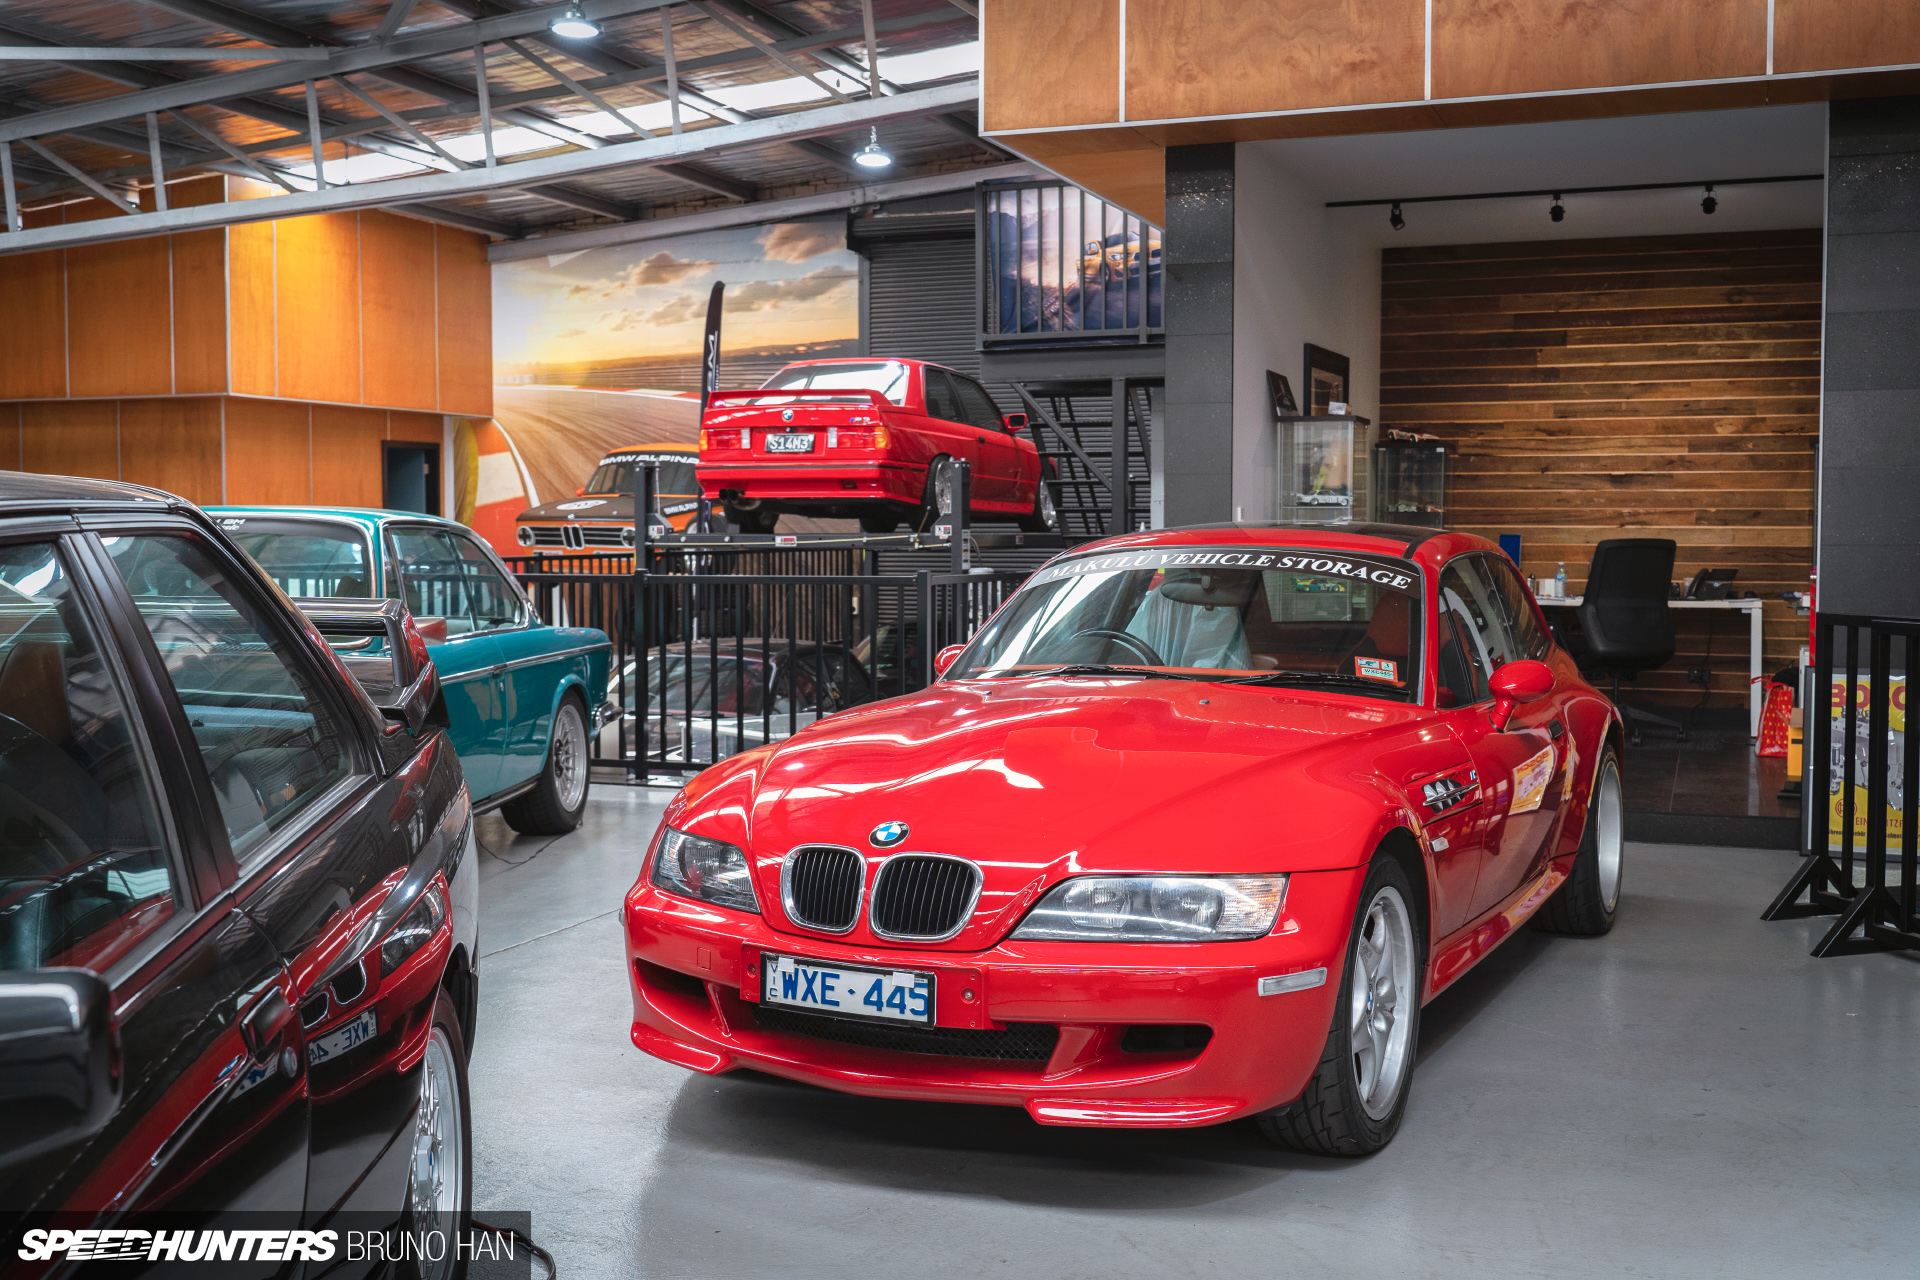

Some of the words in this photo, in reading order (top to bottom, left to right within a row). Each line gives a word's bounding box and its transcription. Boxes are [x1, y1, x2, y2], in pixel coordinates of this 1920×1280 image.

[769, 436, 809, 450] S14M3
[599, 455, 636, 466] BMW
[1045, 554, 1156, 581] MAKULU
[1158, 553, 1275, 567] VEHICLE
[1277, 556, 1412, 590] STORAGE
[769, 963, 779, 997] VIC
[782, 967, 840, 1007] WXE
[863, 977, 928, 1016] 445
